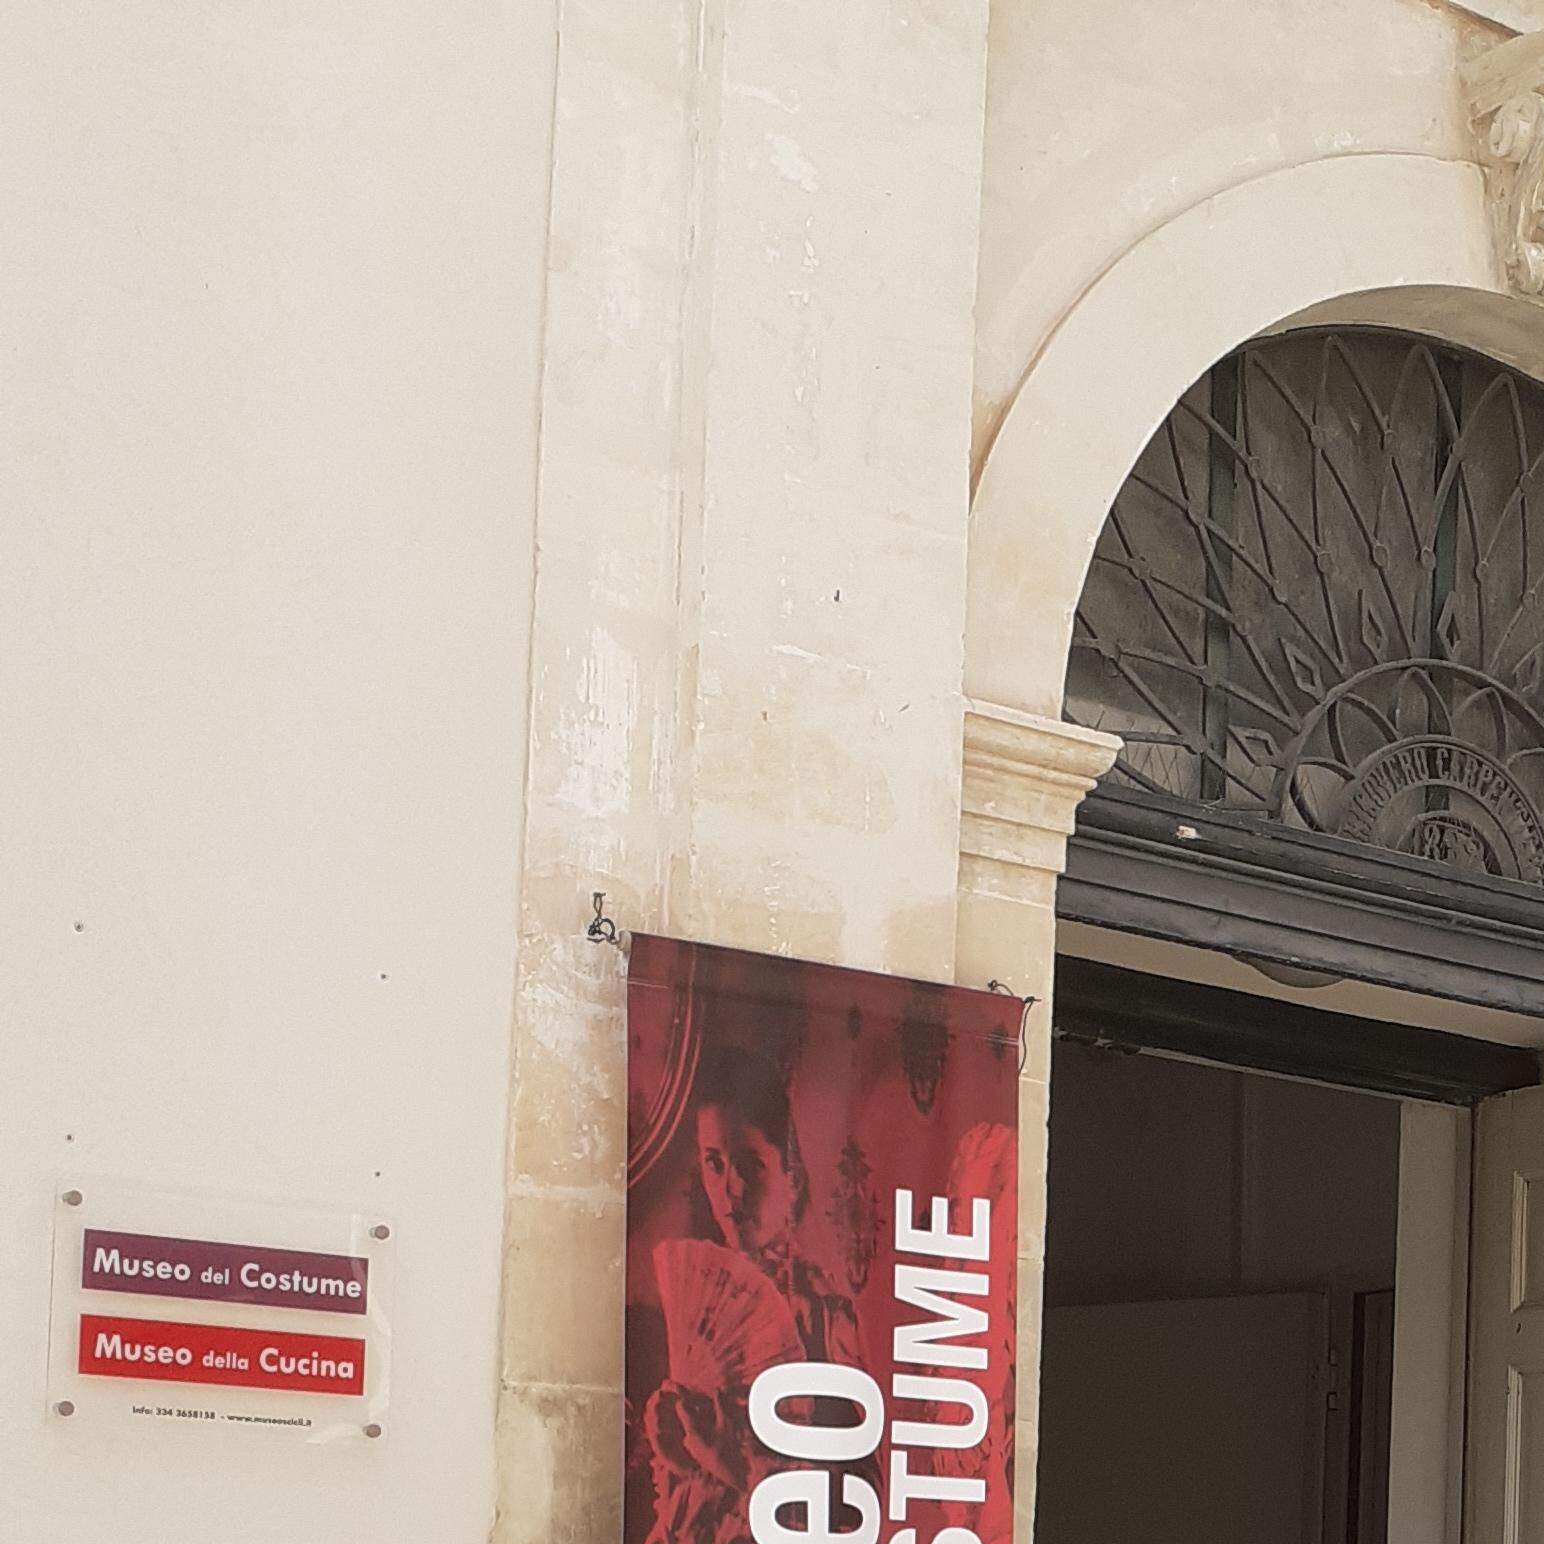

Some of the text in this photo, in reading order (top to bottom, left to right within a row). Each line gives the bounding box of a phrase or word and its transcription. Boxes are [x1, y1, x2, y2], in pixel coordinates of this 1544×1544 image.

[92, 1247, 362, 1298] Museo del Costume
[94, 1333, 354, 1379] Museo della Cucina
[132, 1405, 152, 1415] Info:
